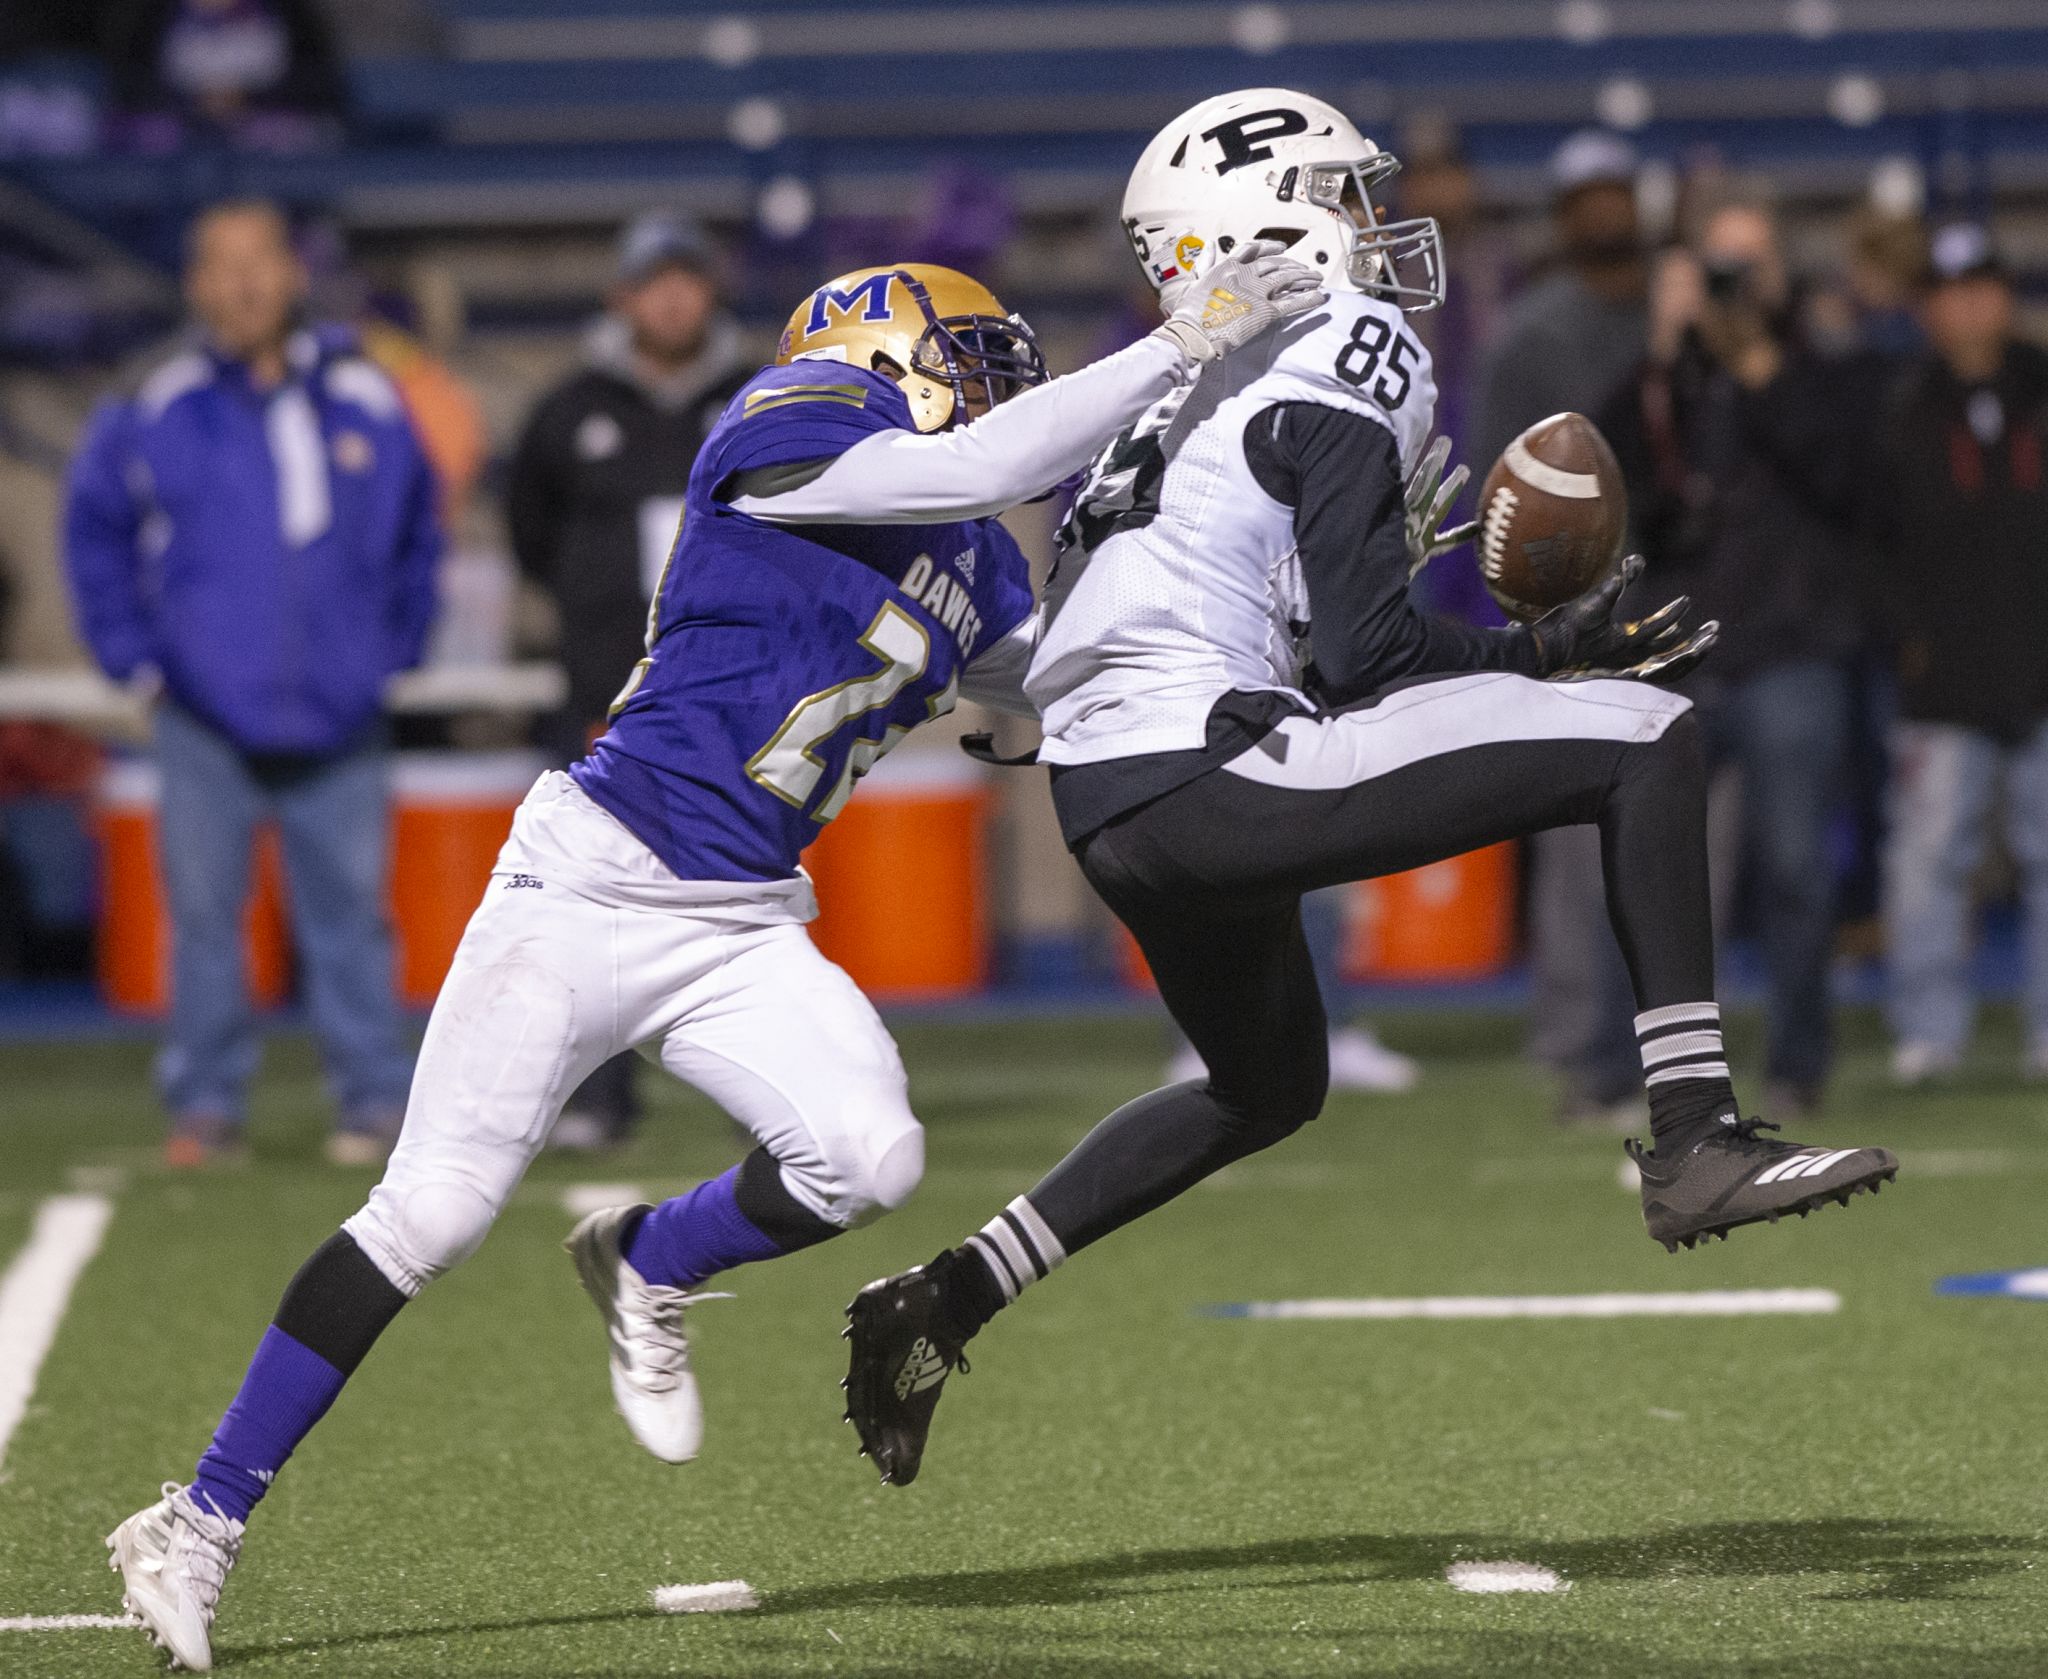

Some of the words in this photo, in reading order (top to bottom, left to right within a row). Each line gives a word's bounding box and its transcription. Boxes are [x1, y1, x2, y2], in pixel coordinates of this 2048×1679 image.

[1200, 108, 1309, 177] P
[804, 271, 897, 338] M
[1335, 314, 1420, 411] 85
[899, 553, 983, 659] DAWGS
